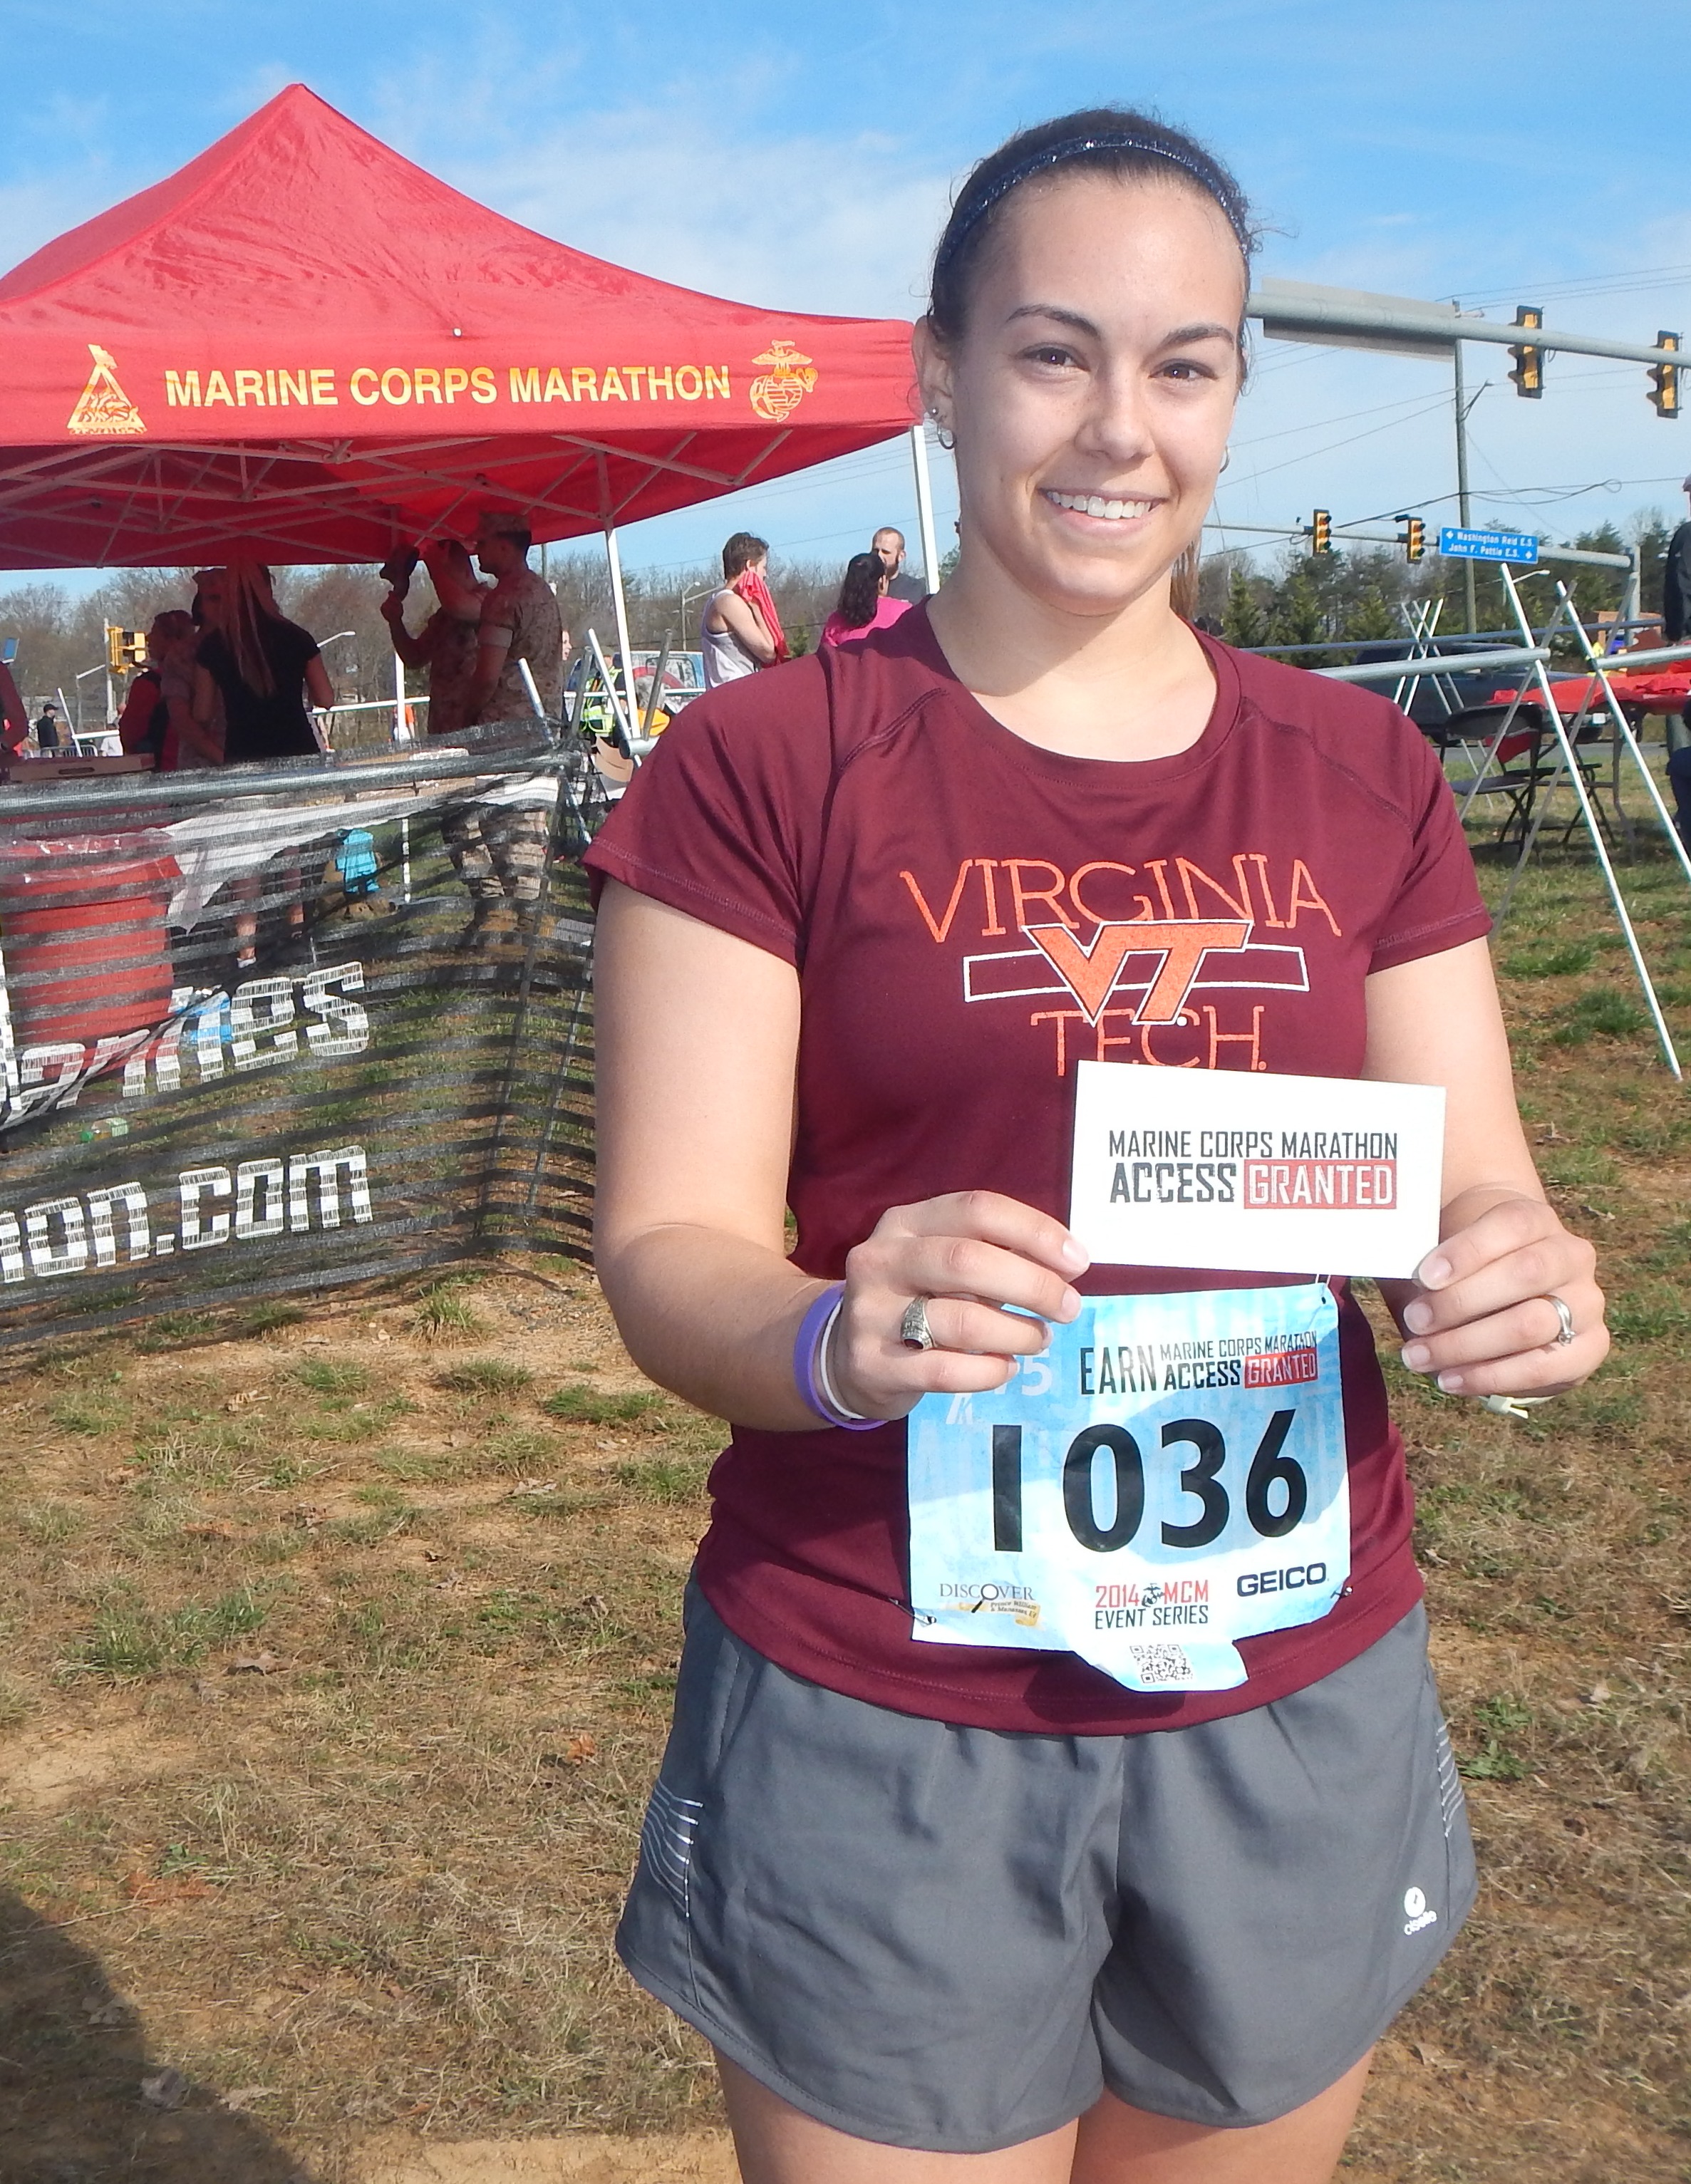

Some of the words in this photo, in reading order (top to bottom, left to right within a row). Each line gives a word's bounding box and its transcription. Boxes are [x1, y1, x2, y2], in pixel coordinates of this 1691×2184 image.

[165, 368, 338, 407] MARINE
[350, 367, 497, 405] CORPS
[509, 364, 731, 403] MARATHON
[1448, 542, 1467, 552] John
[1457, 532, 1499, 544] Washington
[1501, 535, 1518, 545] Reid
[899, 853, 1343, 943] VIRGINIA
[1020, 918, 1255, 1028] VT
[1109, 1129, 1192, 1157] MARINE
[1200, 1131, 1273, 1158] CORPS
[1281, 1132, 1397, 1159] MARATHON
[1110, 1162, 1236, 1204] ACCESS
[1248, 1164, 1394, 1205] GRANTED
[1159, 1340, 1214, 1362] MARINE
[1219, 1337, 1262, 1358] CORPS
[1264, 1330, 1318, 1354] MARATHON
[1080, 1345, 1157, 1395] EARN
[1164, 1359, 1242, 1391] ACCESS
[1247, 1352, 1318, 1385] GRANTED
[991, 1409, 1308, 1553] 1036
[939, 1583, 1036, 1601] DISCOVER
[1095, 1583, 1139, 1608] 2014
[1164, 1579, 1209, 1605] MCM
[1236, 1563, 1327, 1598] GEICO
[1095, 1608, 1147, 1630] EVENT
[1152, 1605, 1209, 1626] SERIES
